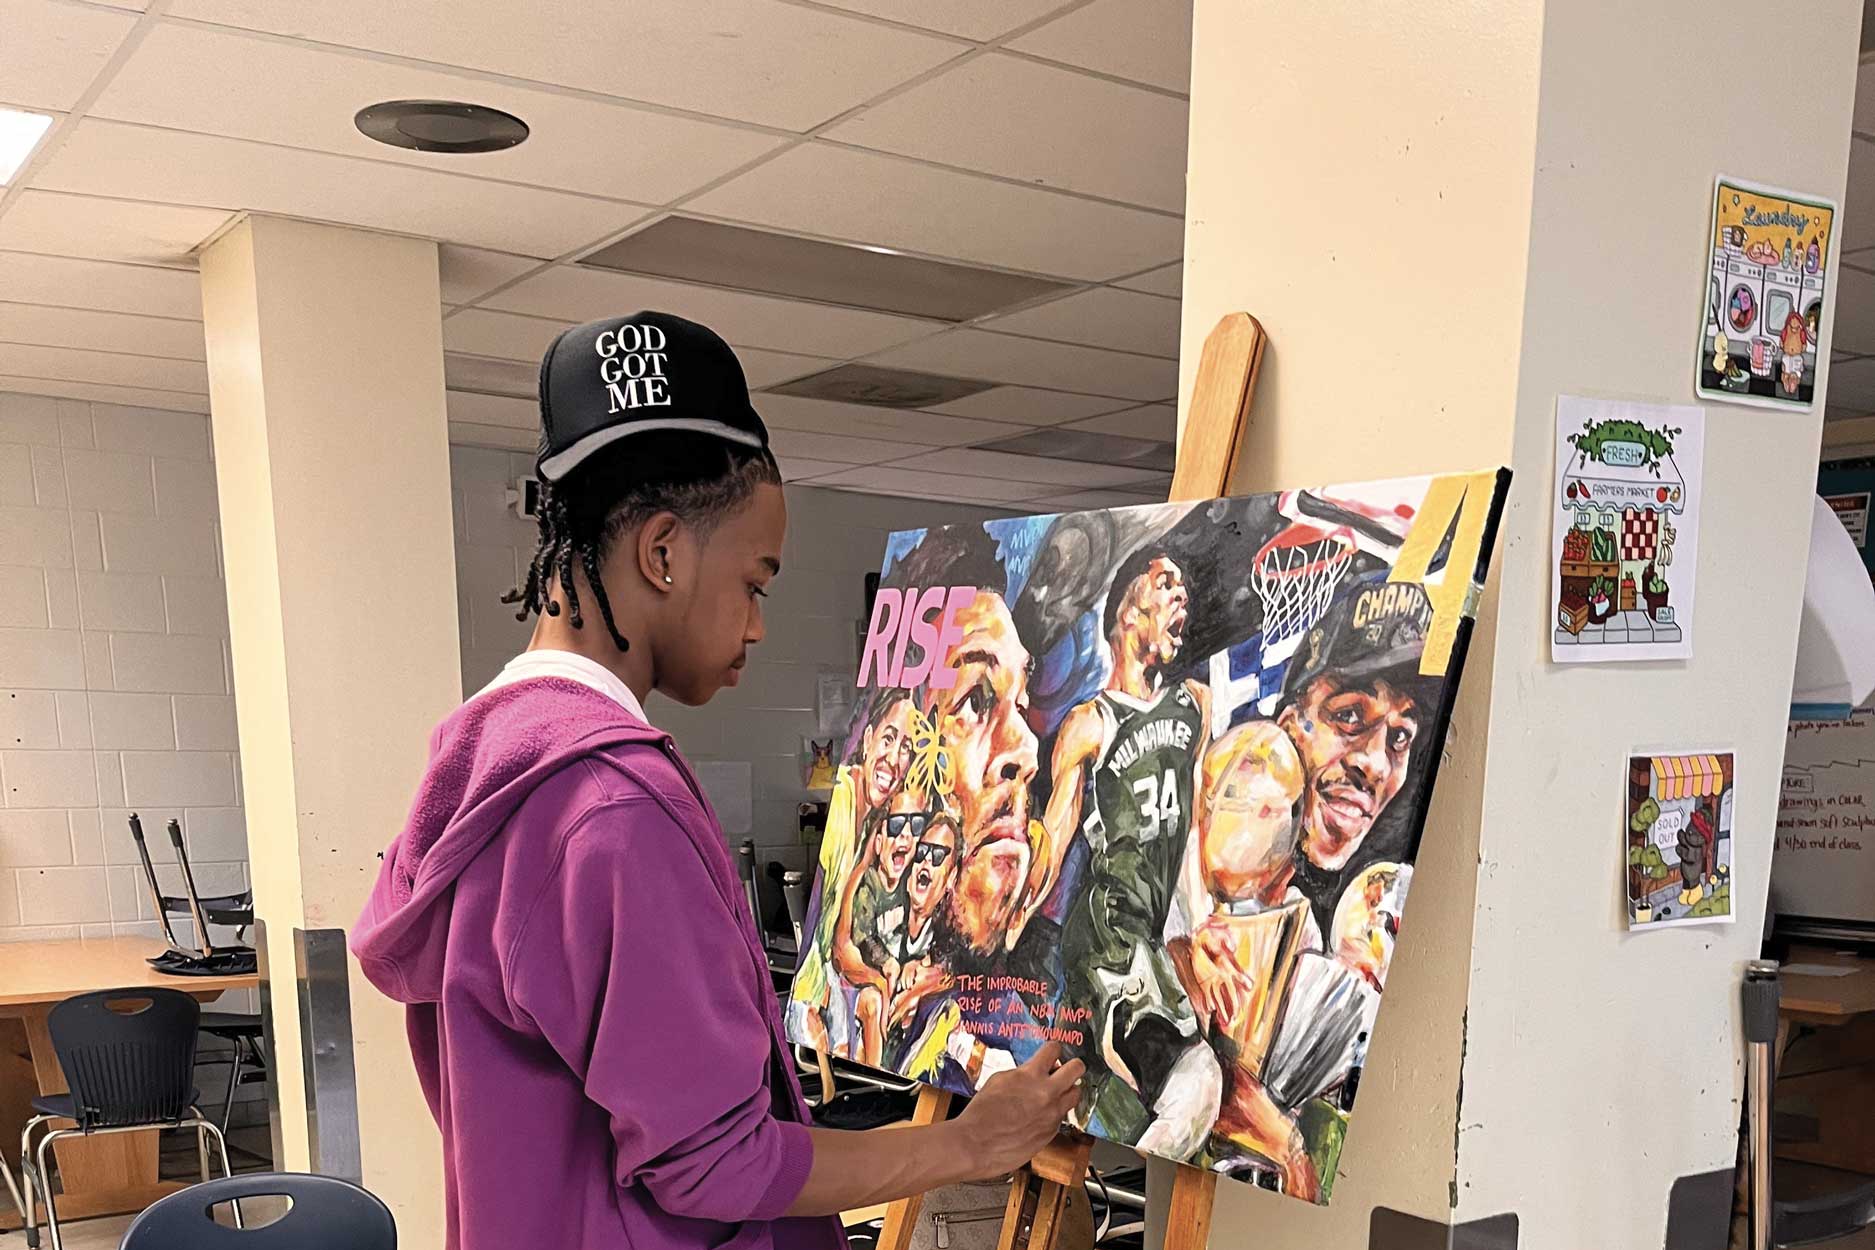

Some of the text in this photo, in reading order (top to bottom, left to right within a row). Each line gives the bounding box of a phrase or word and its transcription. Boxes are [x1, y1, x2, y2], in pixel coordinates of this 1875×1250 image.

[595, 325, 666, 358] GOD
[600, 352, 668, 383] GOT
[605, 377, 672, 413] ME
[1607, 445, 1638, 463] FRESH
[1592, 484, 1655, 498] FARMERS MARKET
[857, 586, 977, 689] RISE
[1133, 769, 1181, 844] 34
[1658, 817, 1679, 831] SOLD
[1659, 831, 1674, 845] OUT
[956, 974, 1047, 997] THE IMPROBABLE
[958, 996, 983, 1014] RISE
[988, 997, 1002, 1013] OF
[1006, 1000, 1024, 1015] AN
[1030, 1002, 1055, 1019] NBA
